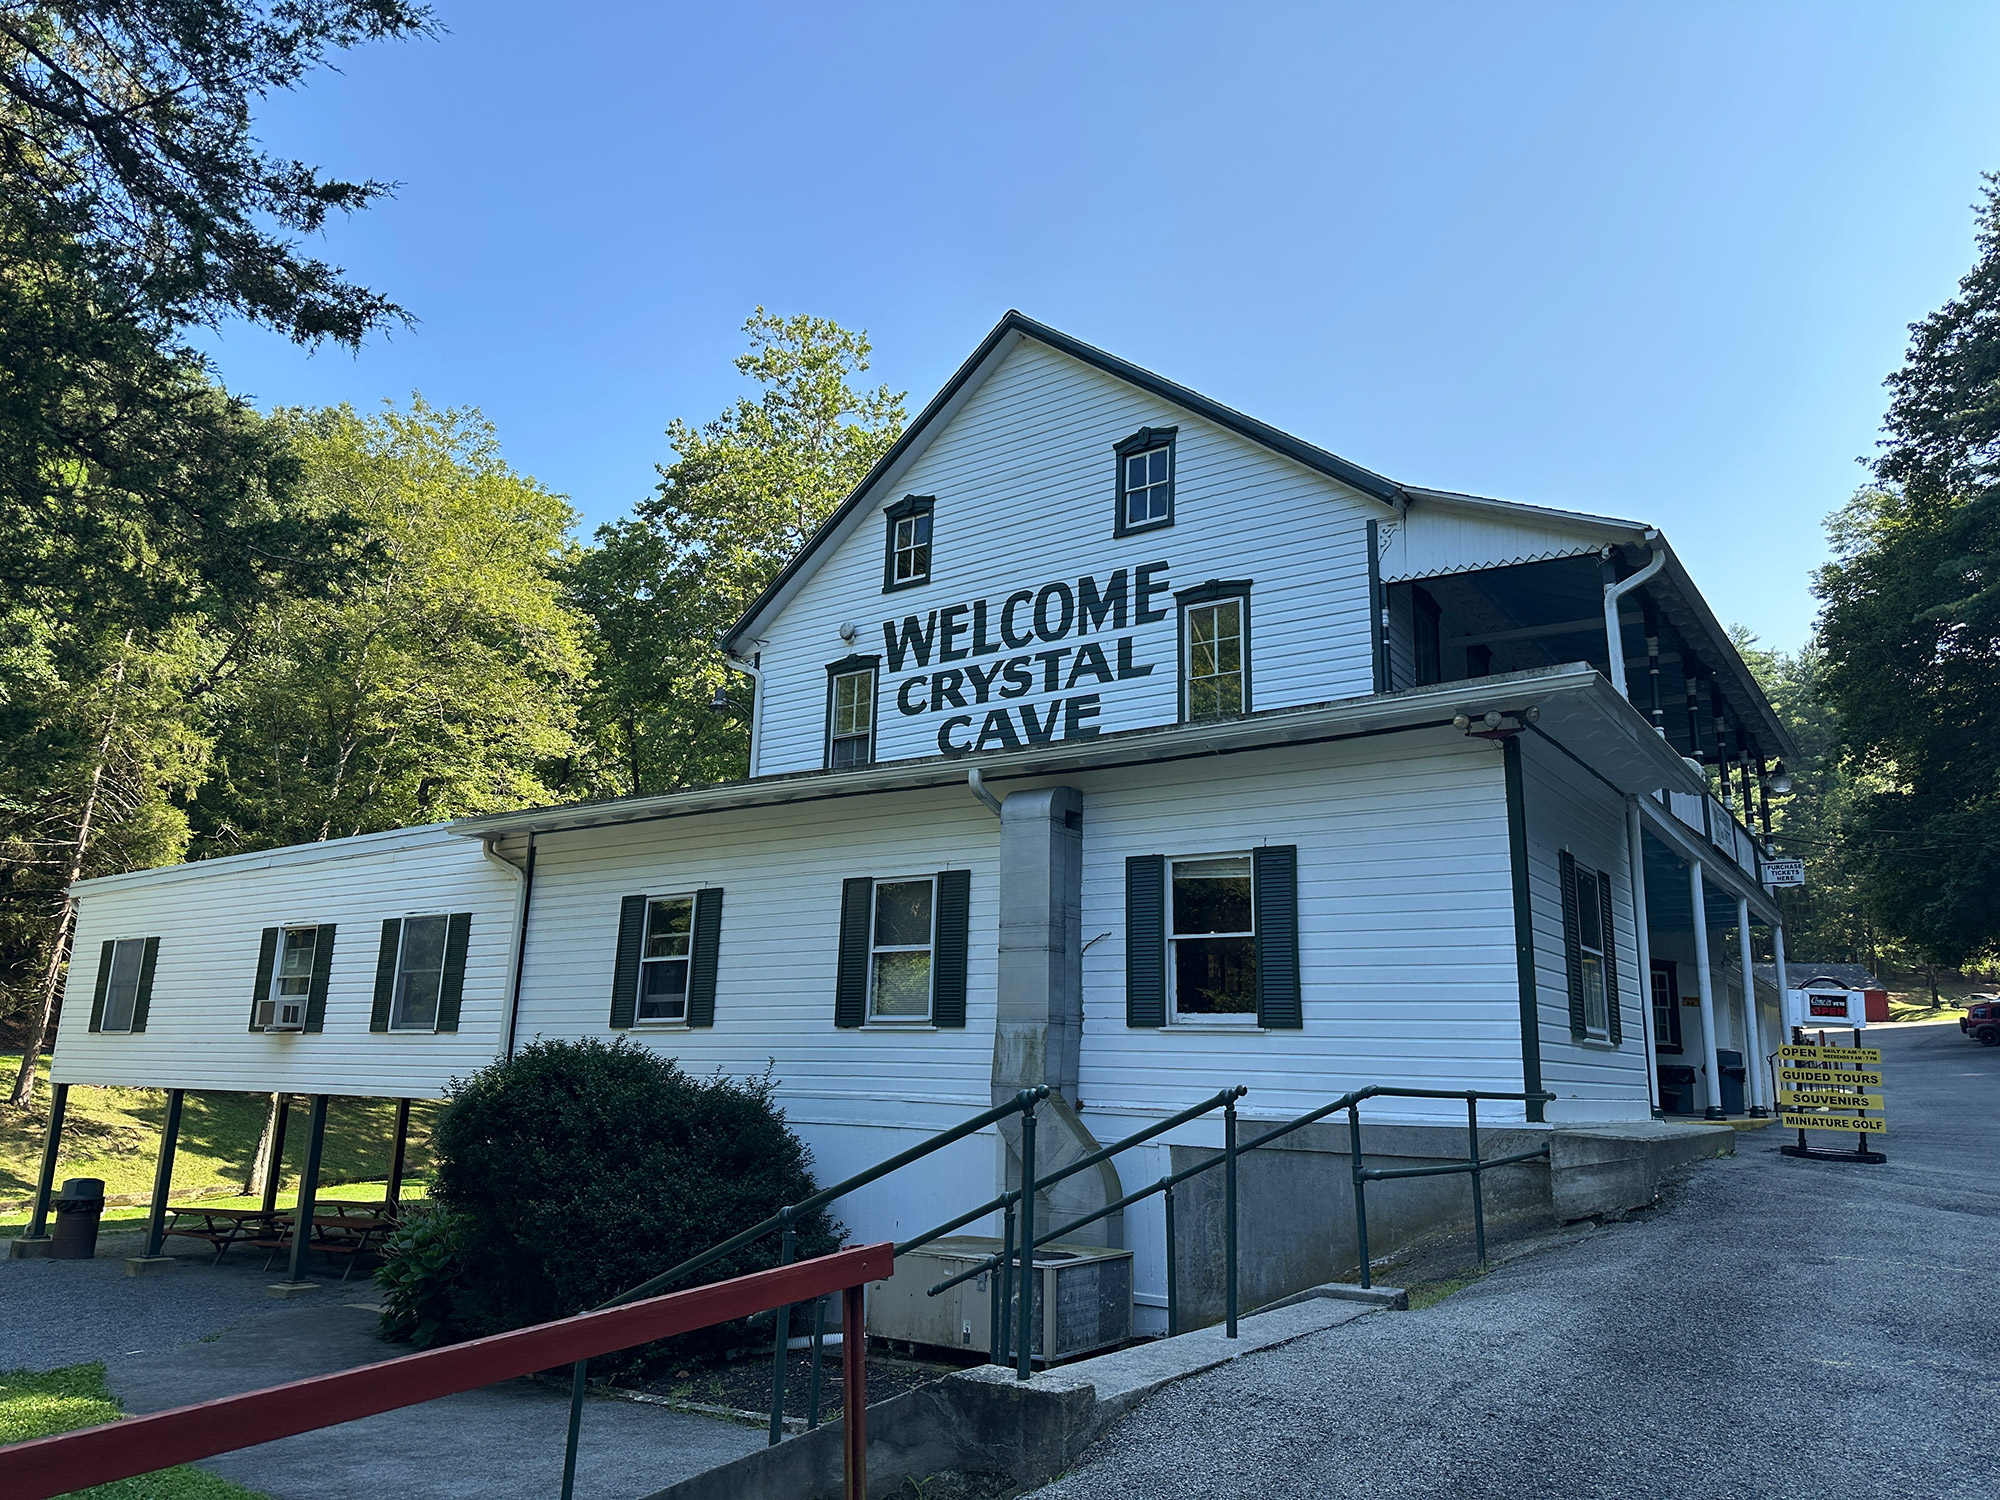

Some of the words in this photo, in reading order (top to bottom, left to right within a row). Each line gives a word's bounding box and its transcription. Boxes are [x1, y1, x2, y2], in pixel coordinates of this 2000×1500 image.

[883, 560, 1170, 673] WELCOME
[897, 636, 1156, 716] CRYSTAL
[937, 693, 1102, 755] CAVE
[1812, 1007, 1846, 1015] OPEN
[1782, 1048, 1817, 1057] OPEN
[1782, 1071, 1830, 1082] GUIDED
[1834, 1073, 1878, 1084] TOURS
[1793, 1094, 1869, 1106] SOUVENIRS
[1786, 1116, 1849, 1128] MINIATURE
[1852, 1120, 1883, 1130] GOLF
